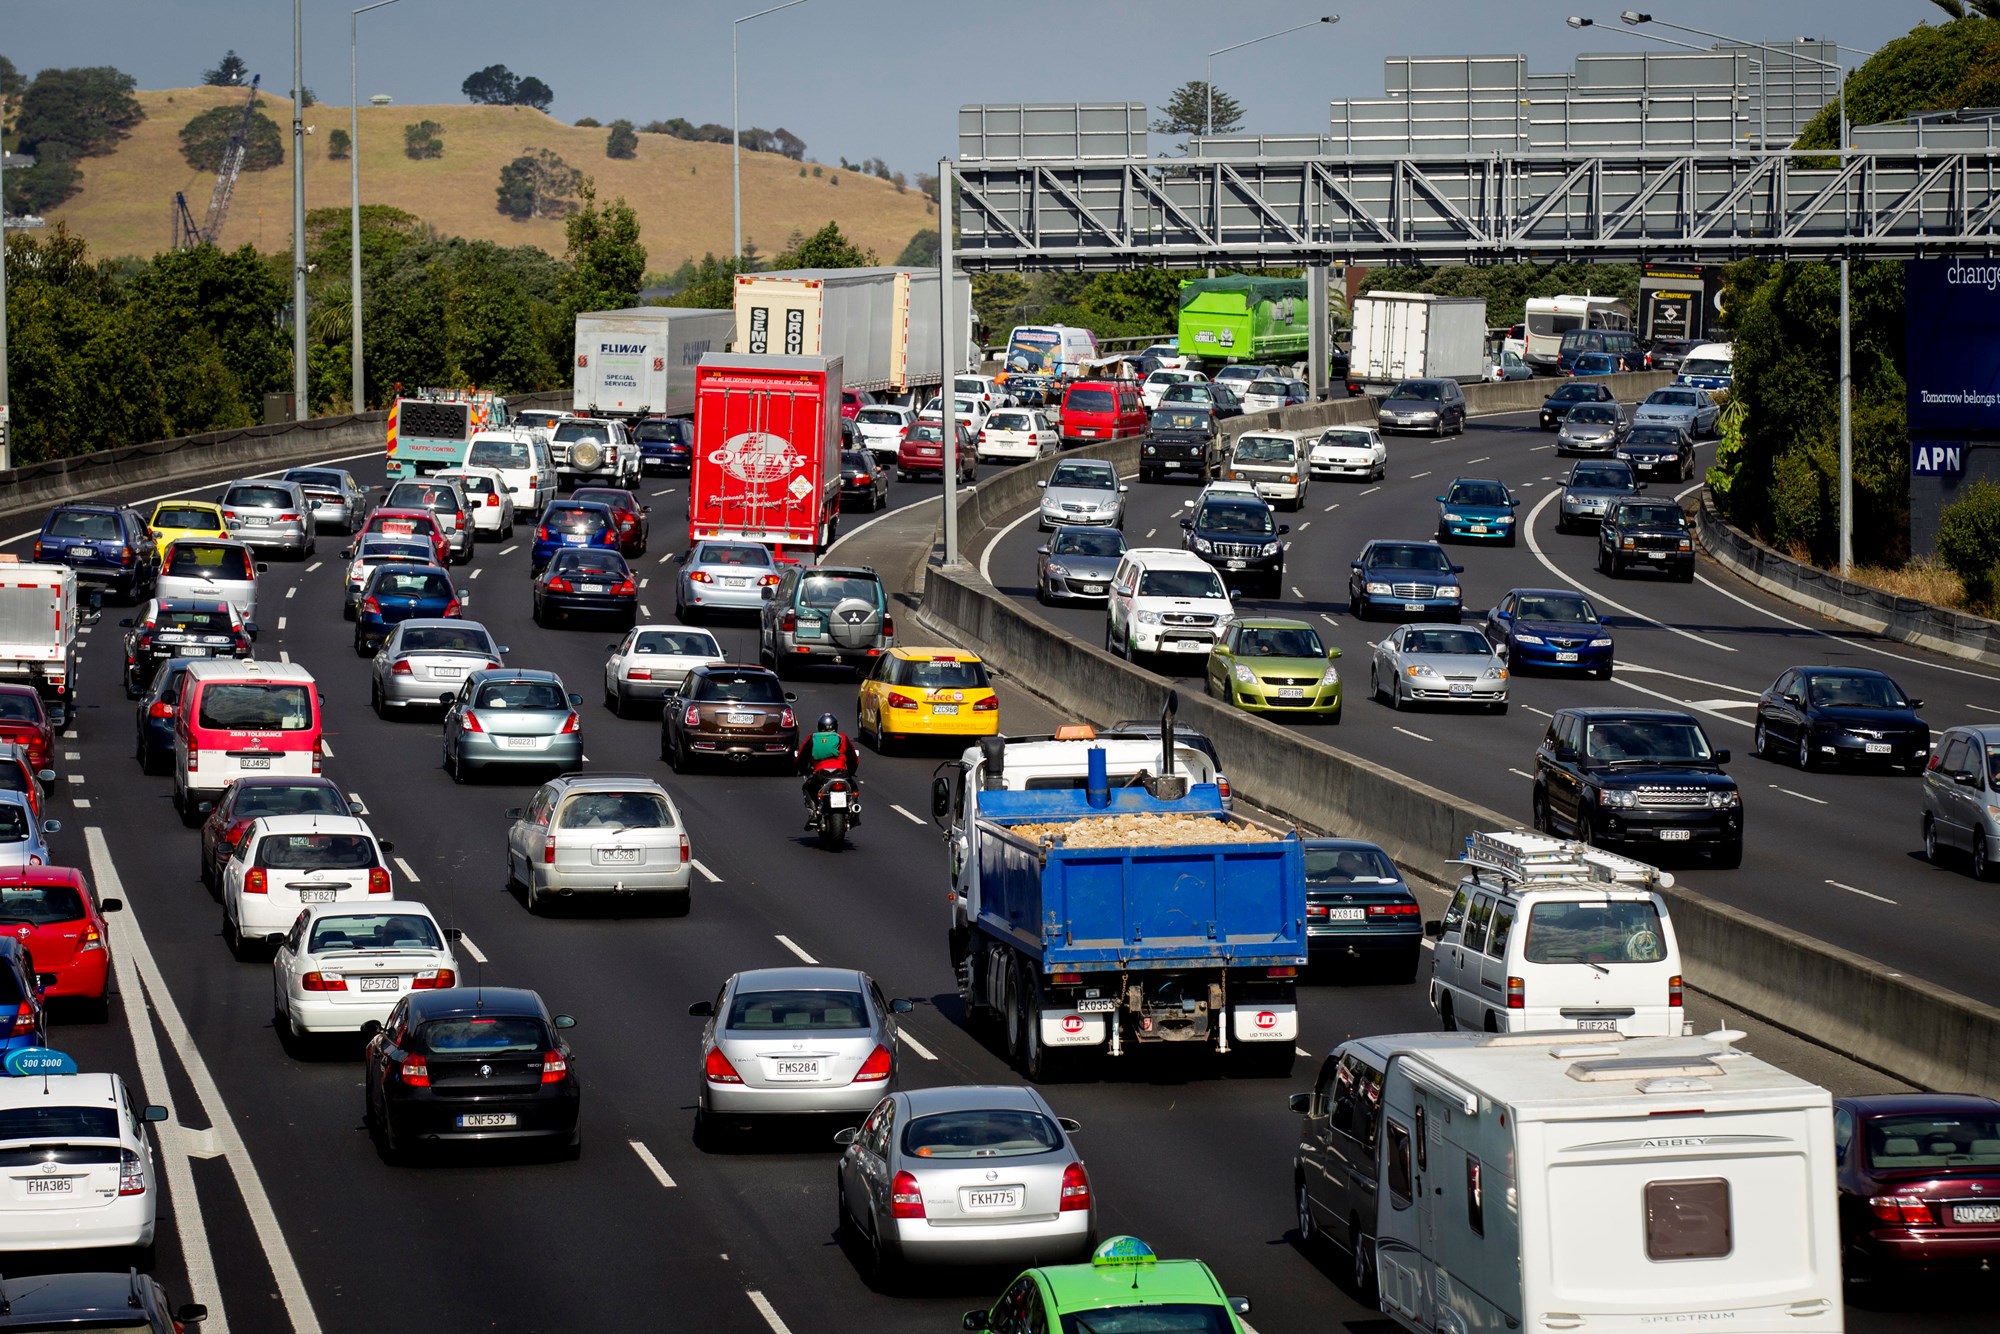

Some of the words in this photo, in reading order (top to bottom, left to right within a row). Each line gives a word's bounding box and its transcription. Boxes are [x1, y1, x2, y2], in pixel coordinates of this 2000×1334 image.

[1921, 390, 1962, 404] Tomorrow
[1963, 389, 1995, 407] belongs
[708, 449, 807, 468] OWENS
[1917, 447, 1961, 471] APN
[926, 693, 951, 702] Pace
[241, 758, 269, 768] DZJ495
[603, 850, 634, 860] CMJ528
[302, 891, 334, 901] BFY827
[1331, 909, 1363, 919] WX8141
[362, 979, 397, 989] ZP5728
[1079, 1000, 1115, 1011] EKQ353
[1062, 1019, 1083, 1029] UD
[1256, 1015, 1276, 1025] UD
[22, 1059, 38, 1068] 300
[40, 1058, 62, 1067] 3000
[779, 1063, 817, 1073] FMS284
[468, 1114, 506, 1125] CNF539
[1643, 1138, 1707, 1148] ABBEY
[29, 1180, 71, 1192] FHA305
[971, 1192, 1014, 1205] FKH775
[1640, 1312, 1735, 1325] SPECTRUM
